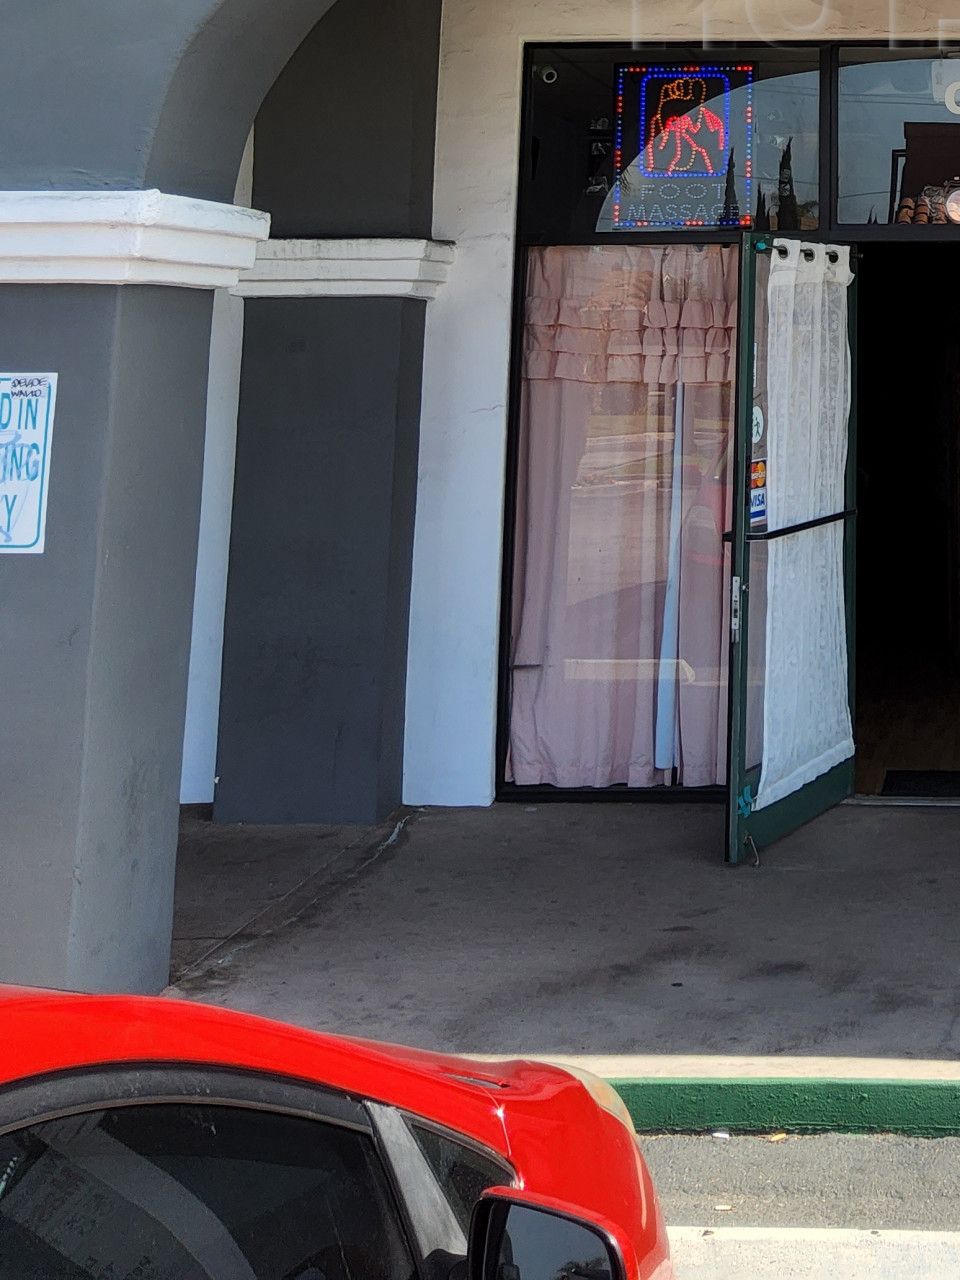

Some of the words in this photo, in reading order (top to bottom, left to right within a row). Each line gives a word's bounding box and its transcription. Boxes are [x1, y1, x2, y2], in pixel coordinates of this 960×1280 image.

[641, 183, 727, 200] FOOT
[627, 203, 740, 221] MASSAGE
[17, 398, 38, 430] IN
